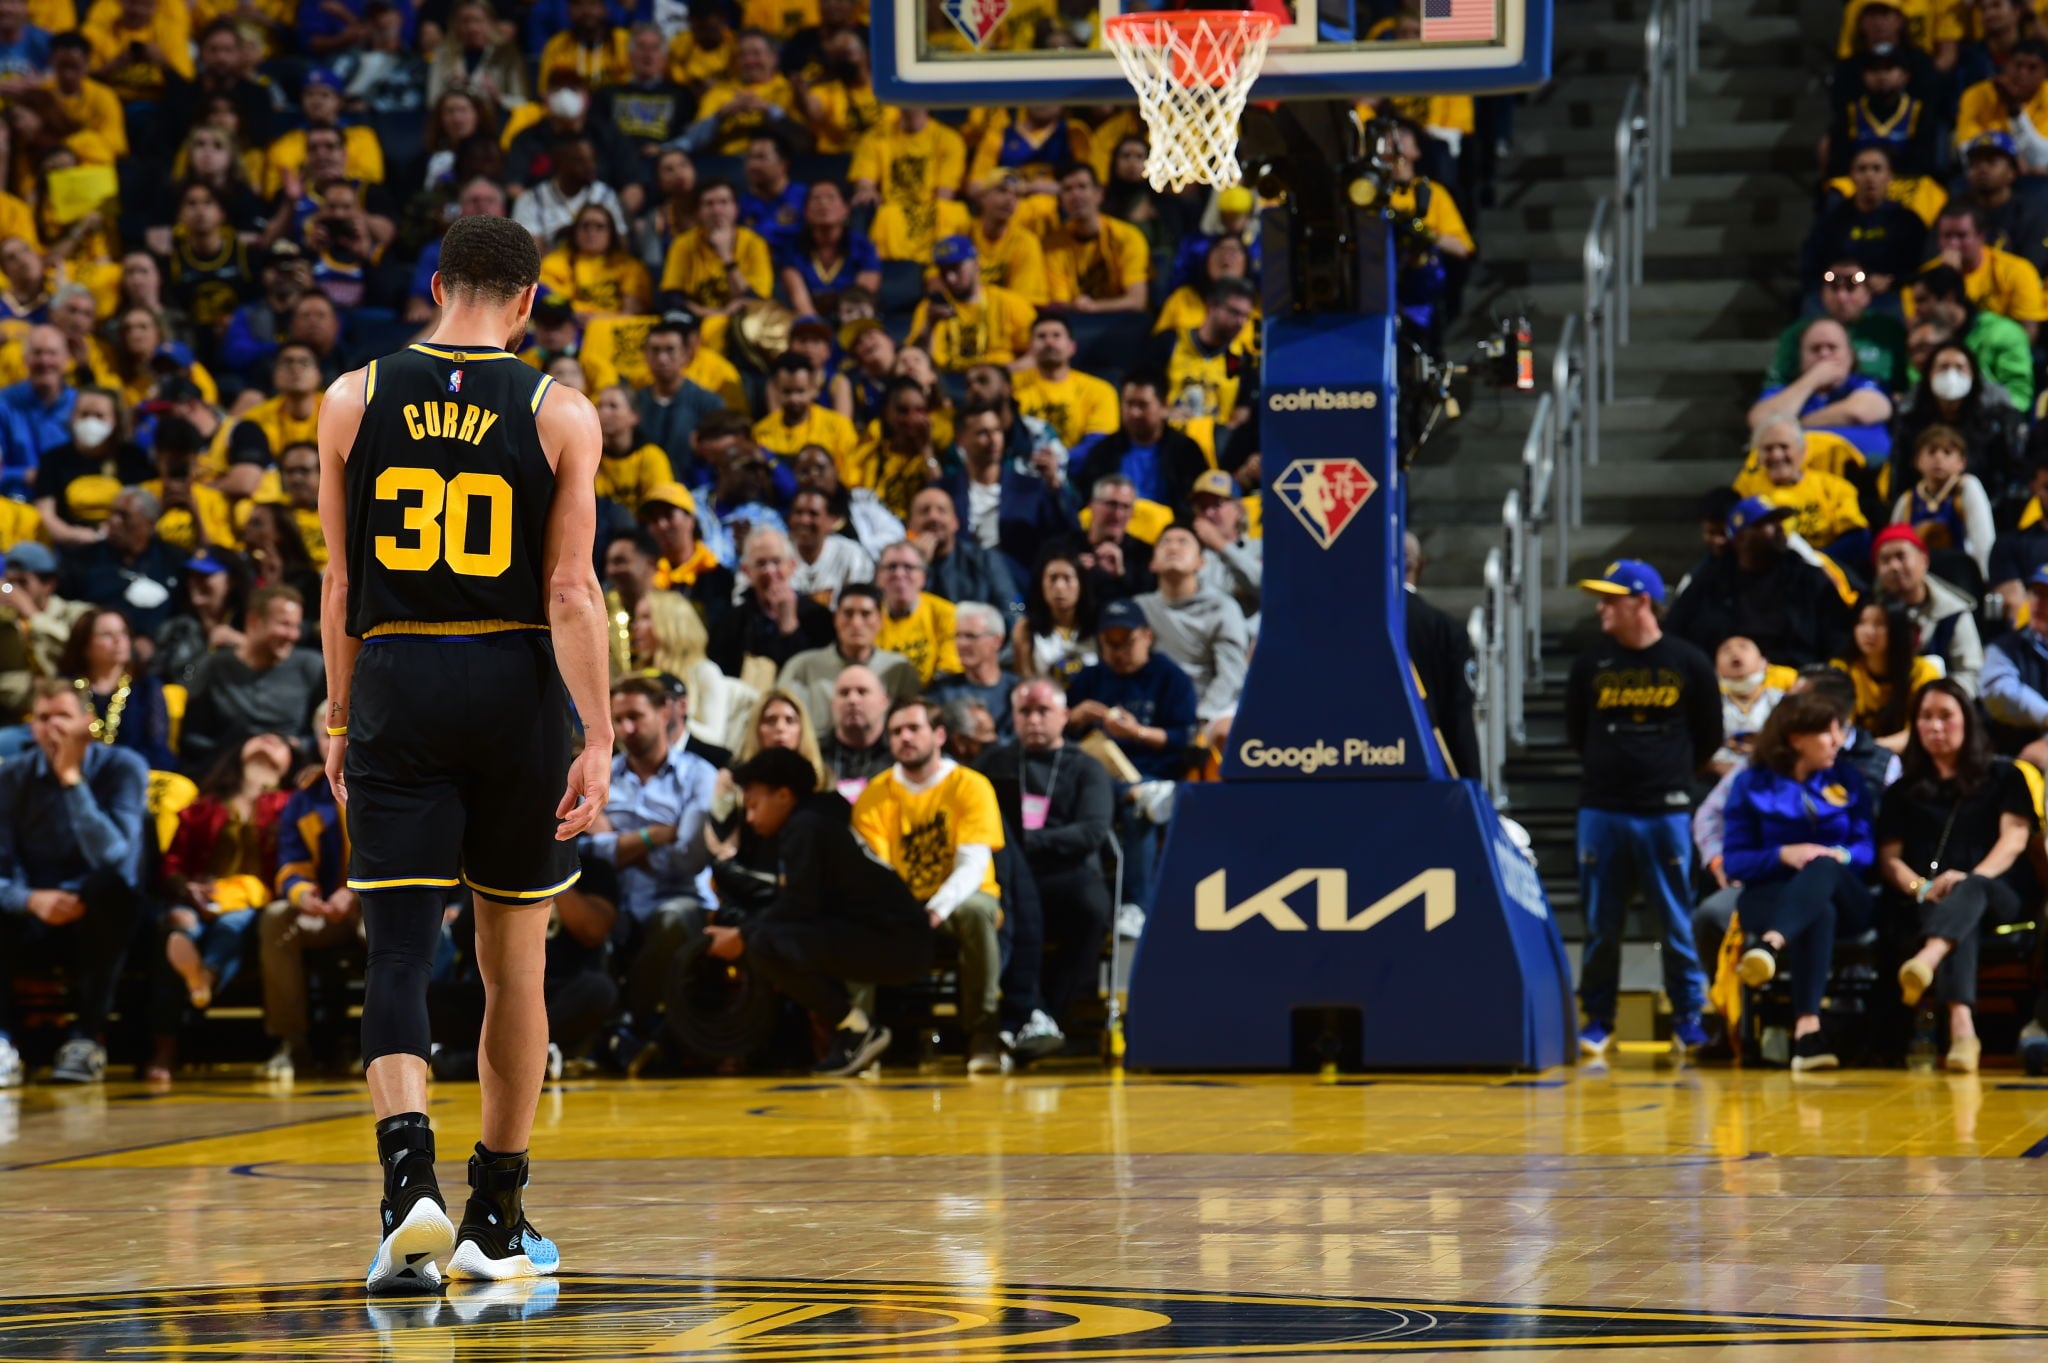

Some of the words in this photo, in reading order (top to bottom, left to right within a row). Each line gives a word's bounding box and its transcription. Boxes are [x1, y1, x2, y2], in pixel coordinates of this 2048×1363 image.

[1269, 387, 1378, 412] coinbase
[403, 401, 499, 446] CURRY
[375, 466, 513, 578] 30
[1240, 738, 1339, 774] Google
[1344, 737, 1405, 766] Pixel
[1195, 868, 1456, 932] KIA
